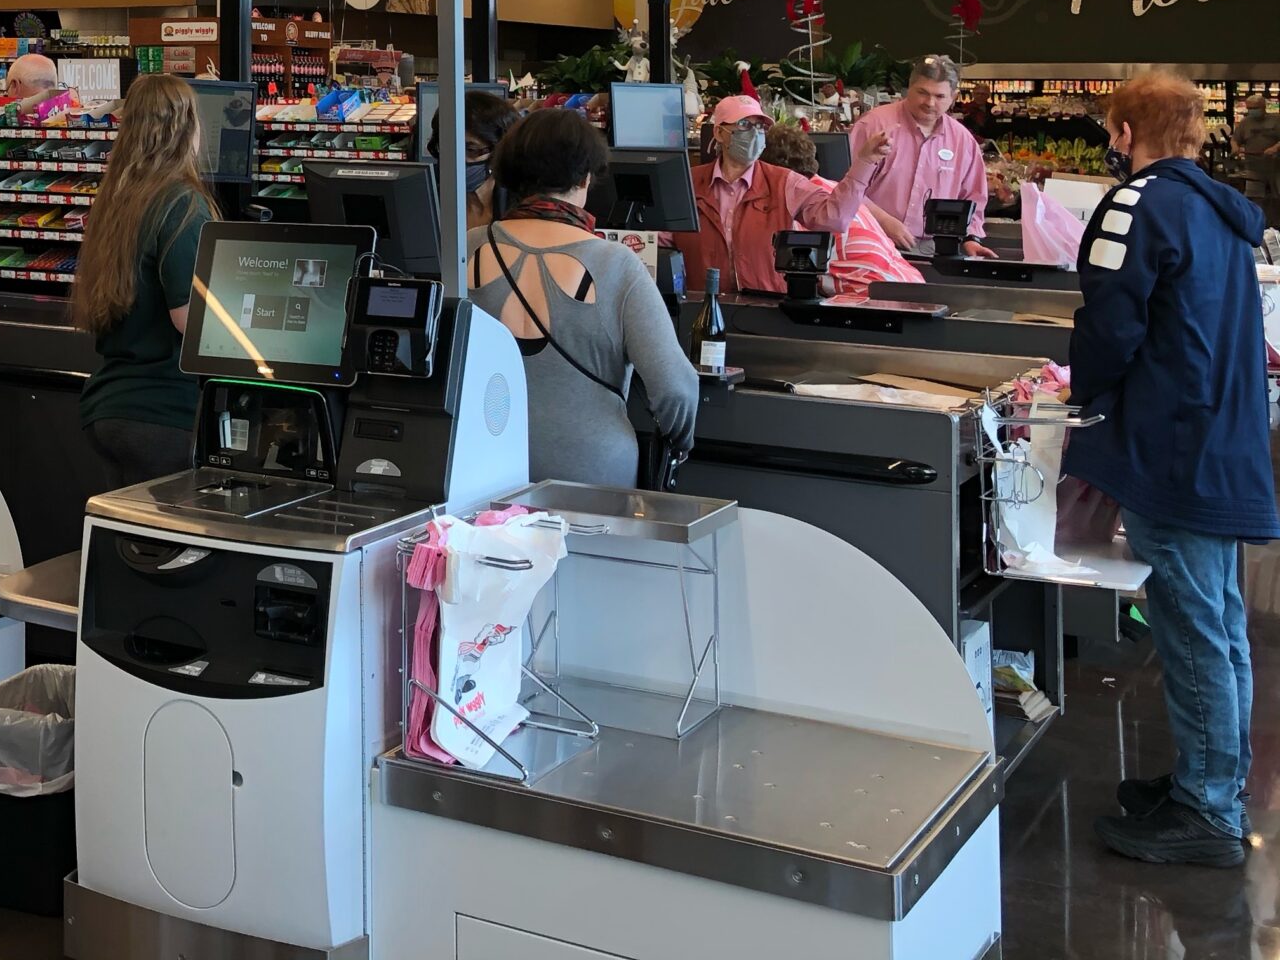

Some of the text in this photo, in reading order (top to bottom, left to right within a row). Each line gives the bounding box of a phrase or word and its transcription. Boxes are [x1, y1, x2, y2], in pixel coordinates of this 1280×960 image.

[175, 26, 214, 35] piggly wiggly
[251, 22, 276, 31] WELCOME
[260, 33, 268, 41] TO
[62, 63, 118, 90] WELCOME
[238, 256, 289, 269] Welcome!
[256, 308, 275, 317] Start
